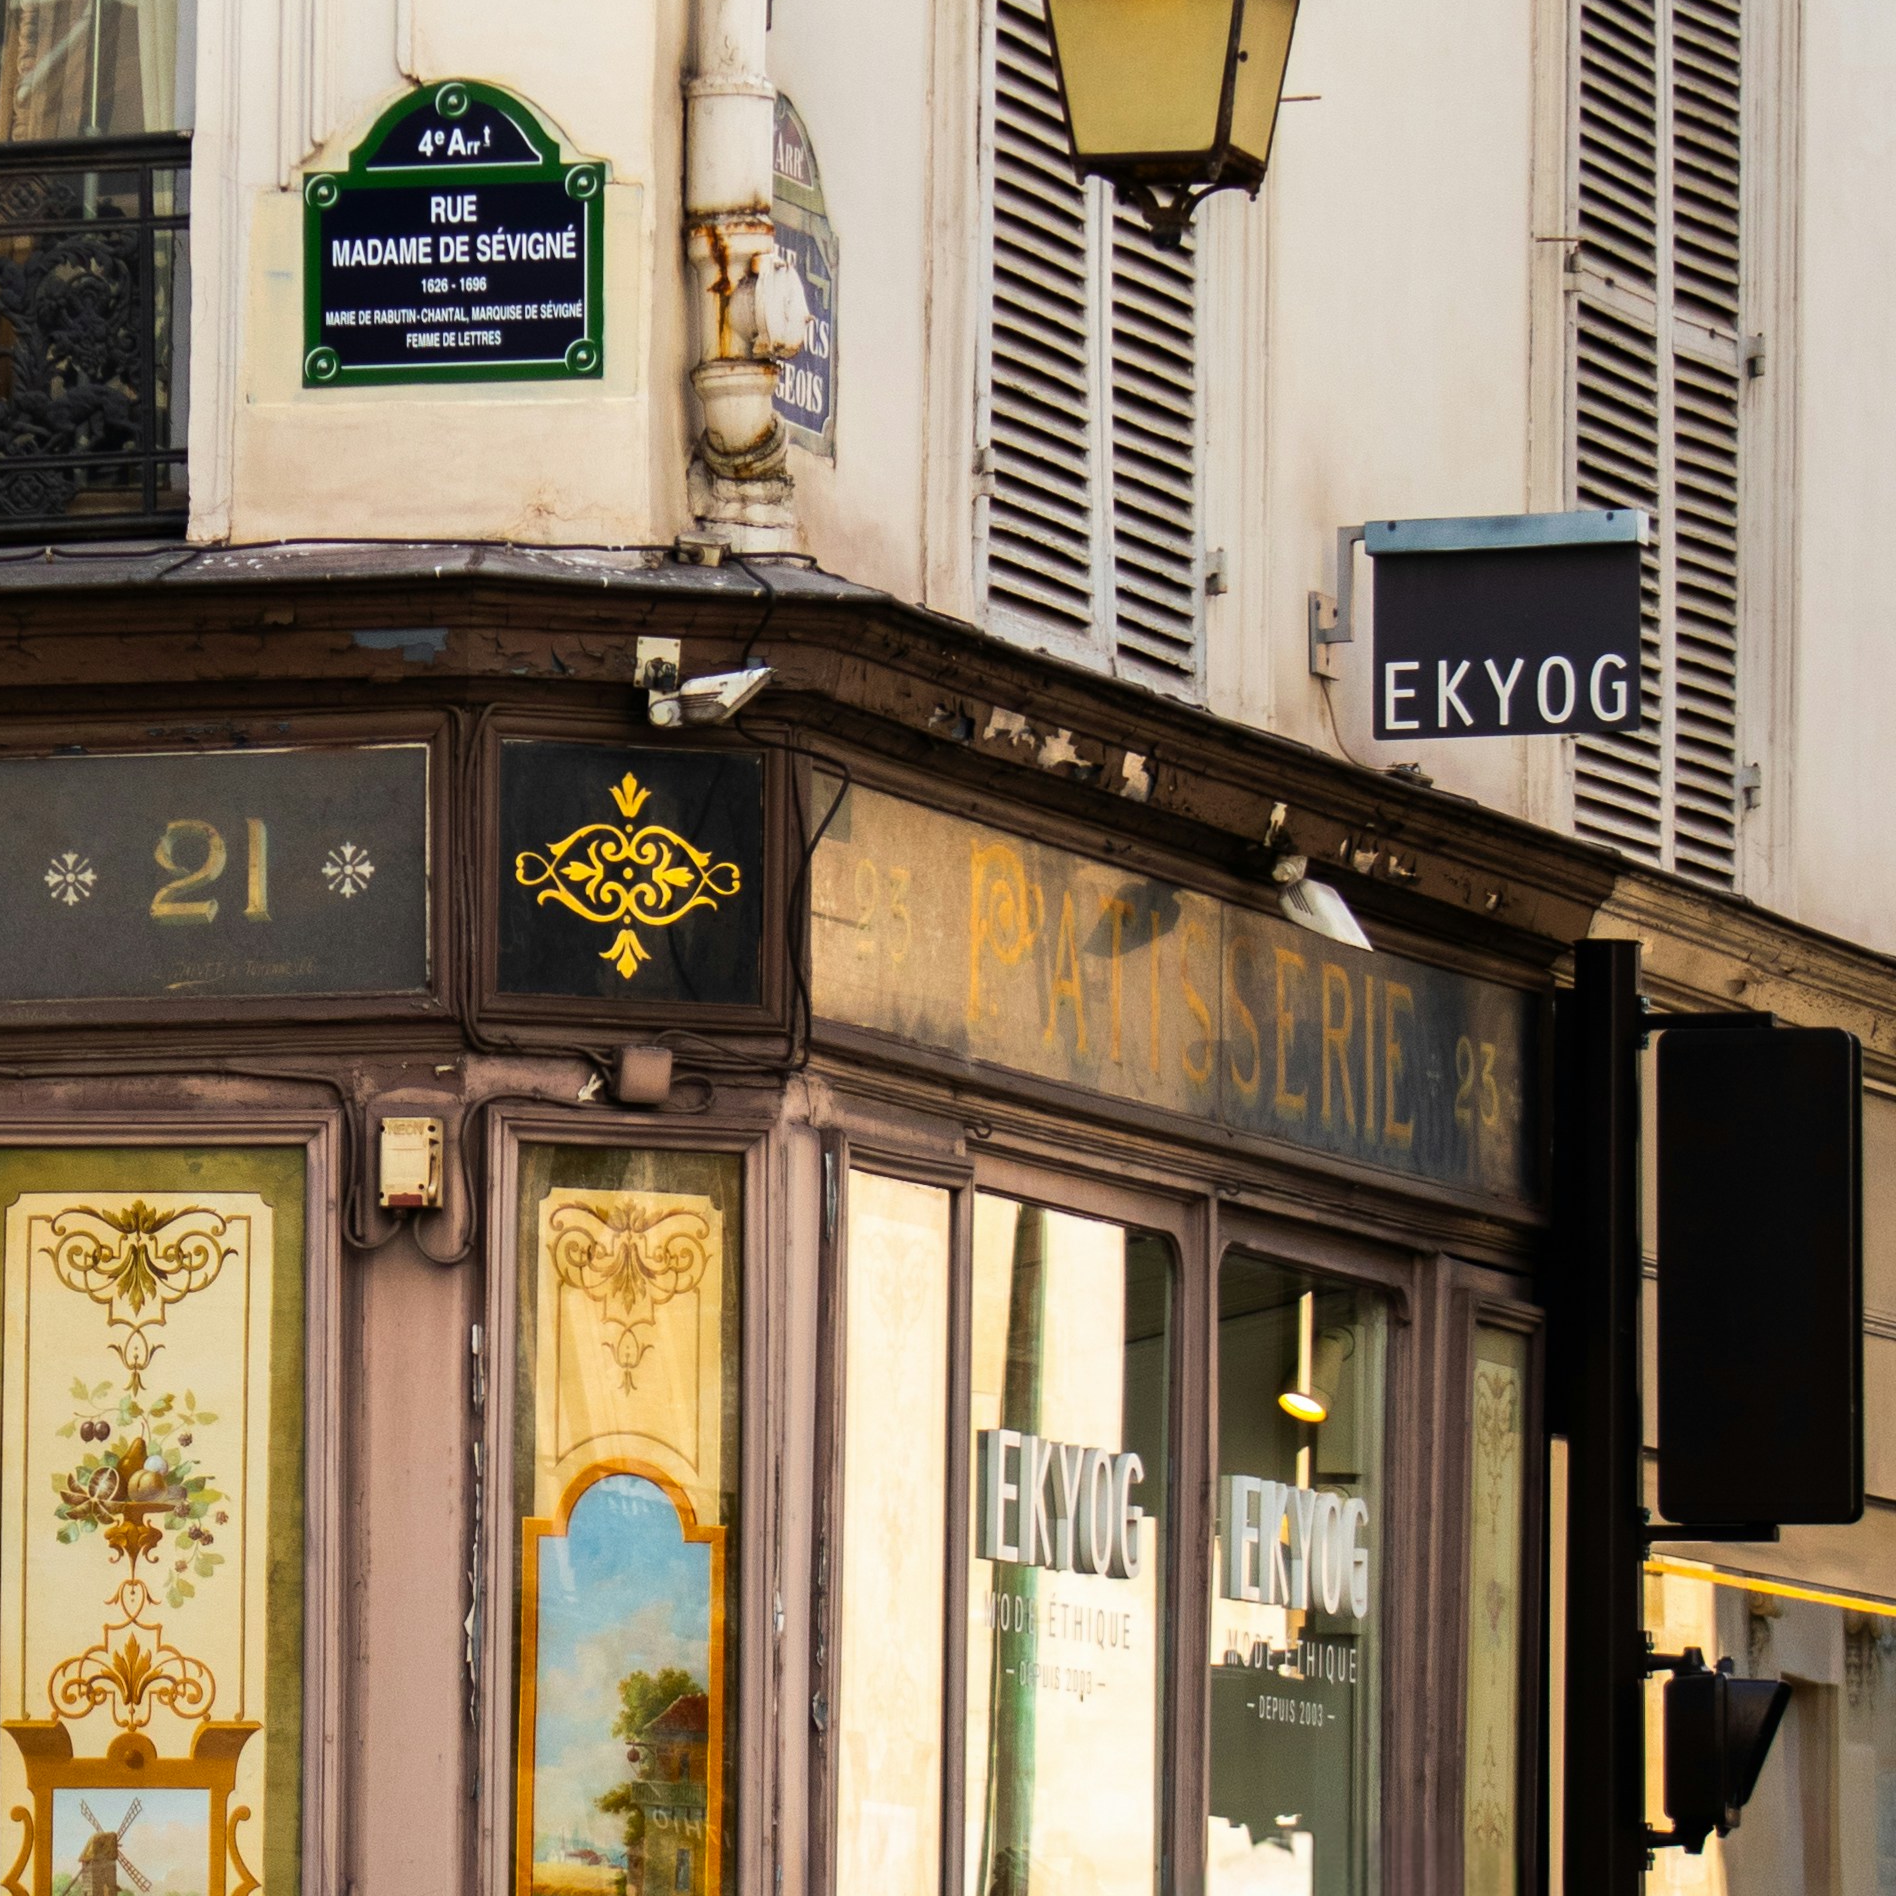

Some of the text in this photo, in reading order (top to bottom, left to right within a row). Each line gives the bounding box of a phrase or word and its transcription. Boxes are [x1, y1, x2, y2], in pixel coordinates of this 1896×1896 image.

[430, 194, 477, 223] RUE
[332, 224, 577, 267] MADAME DE SÉVIGNÉ
[421, 277, 449, 293] 1626
[460, 276, 487, 292] 1696
[325, 311, 356, 326] MARIE
[358, 310, 373, 324] DE
[472, 305, 523, 322] MARQUISE
[524, 304, 538, 319] DE
[540, 299, 583, 319] SÉVIGNÉ
[406, 330, 502, 348] FEMME DE LETTRES
[1384, 653, 1629, 732] EKYOG
[150, 818, 271, 926] 21
[966, 837, 1416, 1150] PATISSERIE
[1455, 1034, 1499, 1130] 23
[977, 1429, 1145, 1579] EKYOG
[1221, 1474, 1370, 1619] EKYOG
[985, 1591, 1130, 1650] MODE ÉTHIQUE
[1019, 1660, 1060, 1690] DEPUIS
[1226, 1629, 1357, 1684] MODE ÉTHIQUE
[1258, 1694, 1323, 1727] DEPUIS 2003
